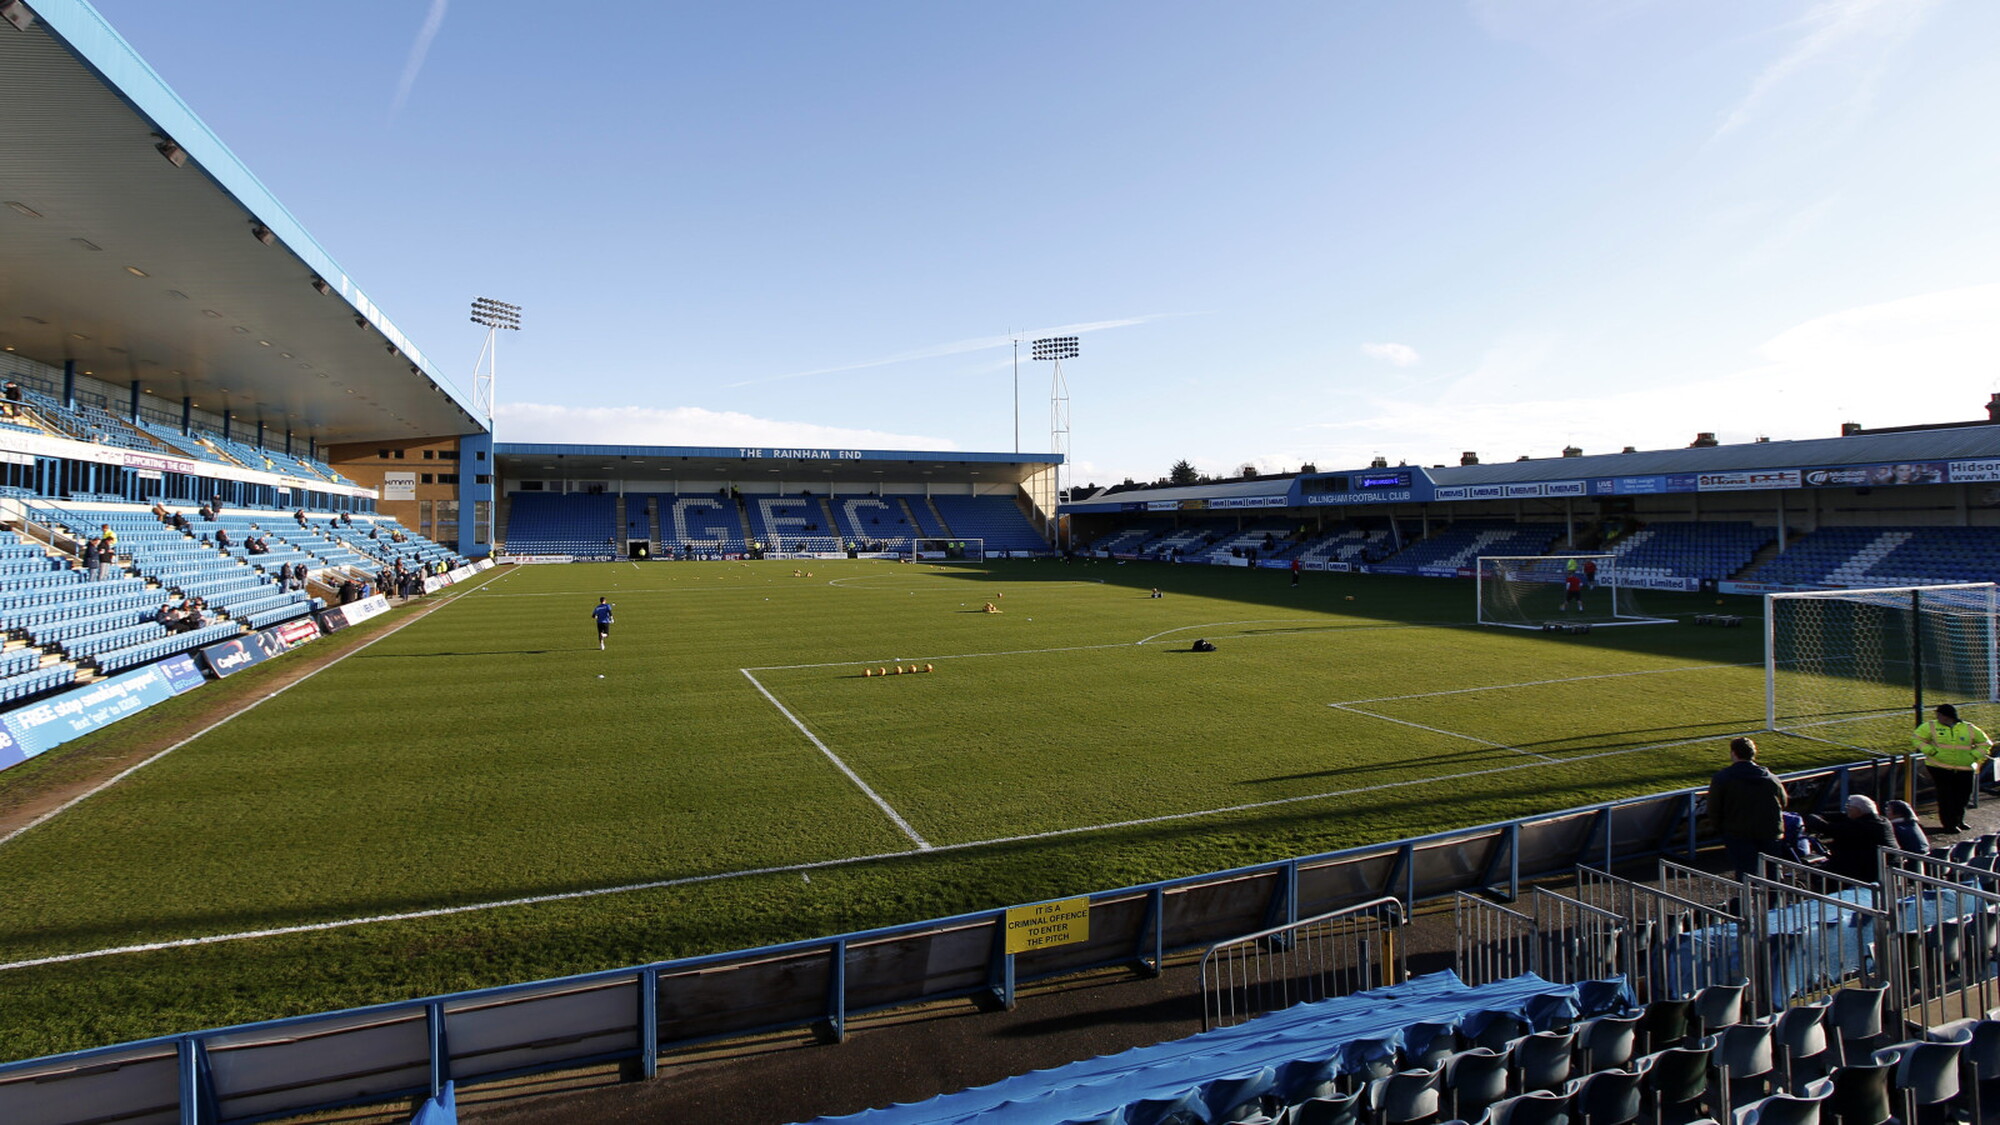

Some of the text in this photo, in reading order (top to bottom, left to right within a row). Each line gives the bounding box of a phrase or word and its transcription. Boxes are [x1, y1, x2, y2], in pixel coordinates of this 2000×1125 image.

[740, 448, 862, 459] THE RAINHAM END
[124, 454, 165, 470] SUPPORTING
[166, 459, 179, 470] THE
[1308, 491, 1411, 504] GILLINGHAM FOOTBALL CLUB
[1620, 576, 1646, 588] (Kent)
[1649, 578, 1683, 588] Limited
[16, 703, 58, 730] FREE
[53, 698, 83, 718] stop
[80, 683, 127, 707] smoking
[123, 669, 159, 692] support
[69, 717, 93, 731] Text
[110, 704, 121, 715] to
[1036, 904, 1061, 915] IT IS A
[1008, 910, 1087, 930] CRIMINAL OFFENCE
[1028, 923, 1068, 937] TO ENTER
[1027, 933, 1070, 947] THE PITCH
